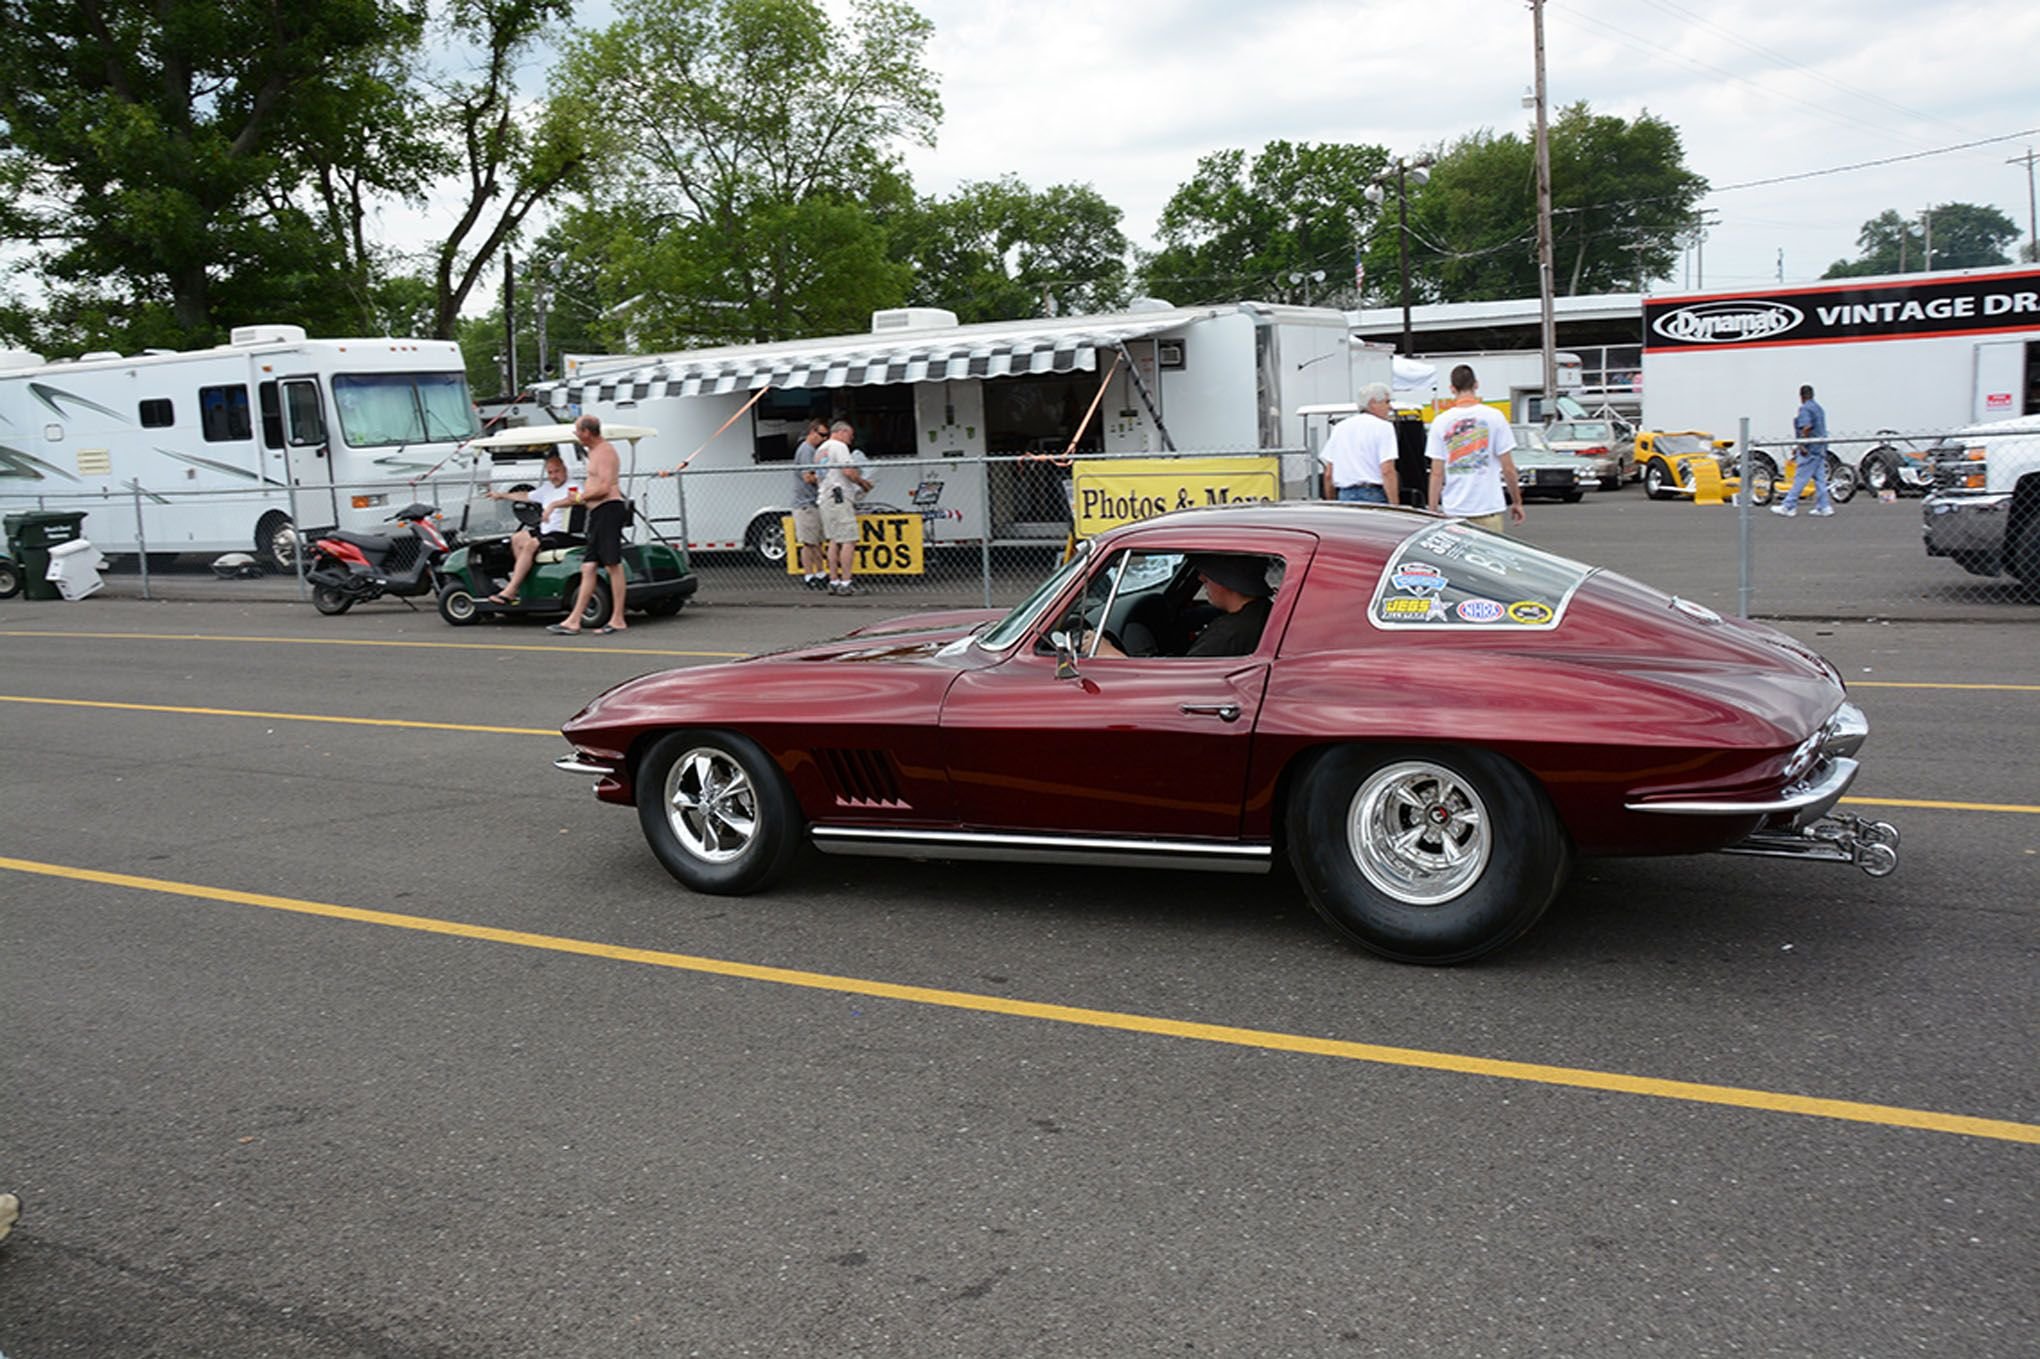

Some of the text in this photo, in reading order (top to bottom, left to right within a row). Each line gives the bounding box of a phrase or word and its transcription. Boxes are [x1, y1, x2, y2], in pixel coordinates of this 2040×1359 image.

[1677, 308, 1780, 338] Dynamat
[1816, 291, 2040, 326] VINTAGE DR
[1082, 489, 1166, 519] Photos
[1175, 488, 1195, 509] &
[1386, 599, 1431, 613] JEGS
[1465, 603, 1498, 618] NHRA
